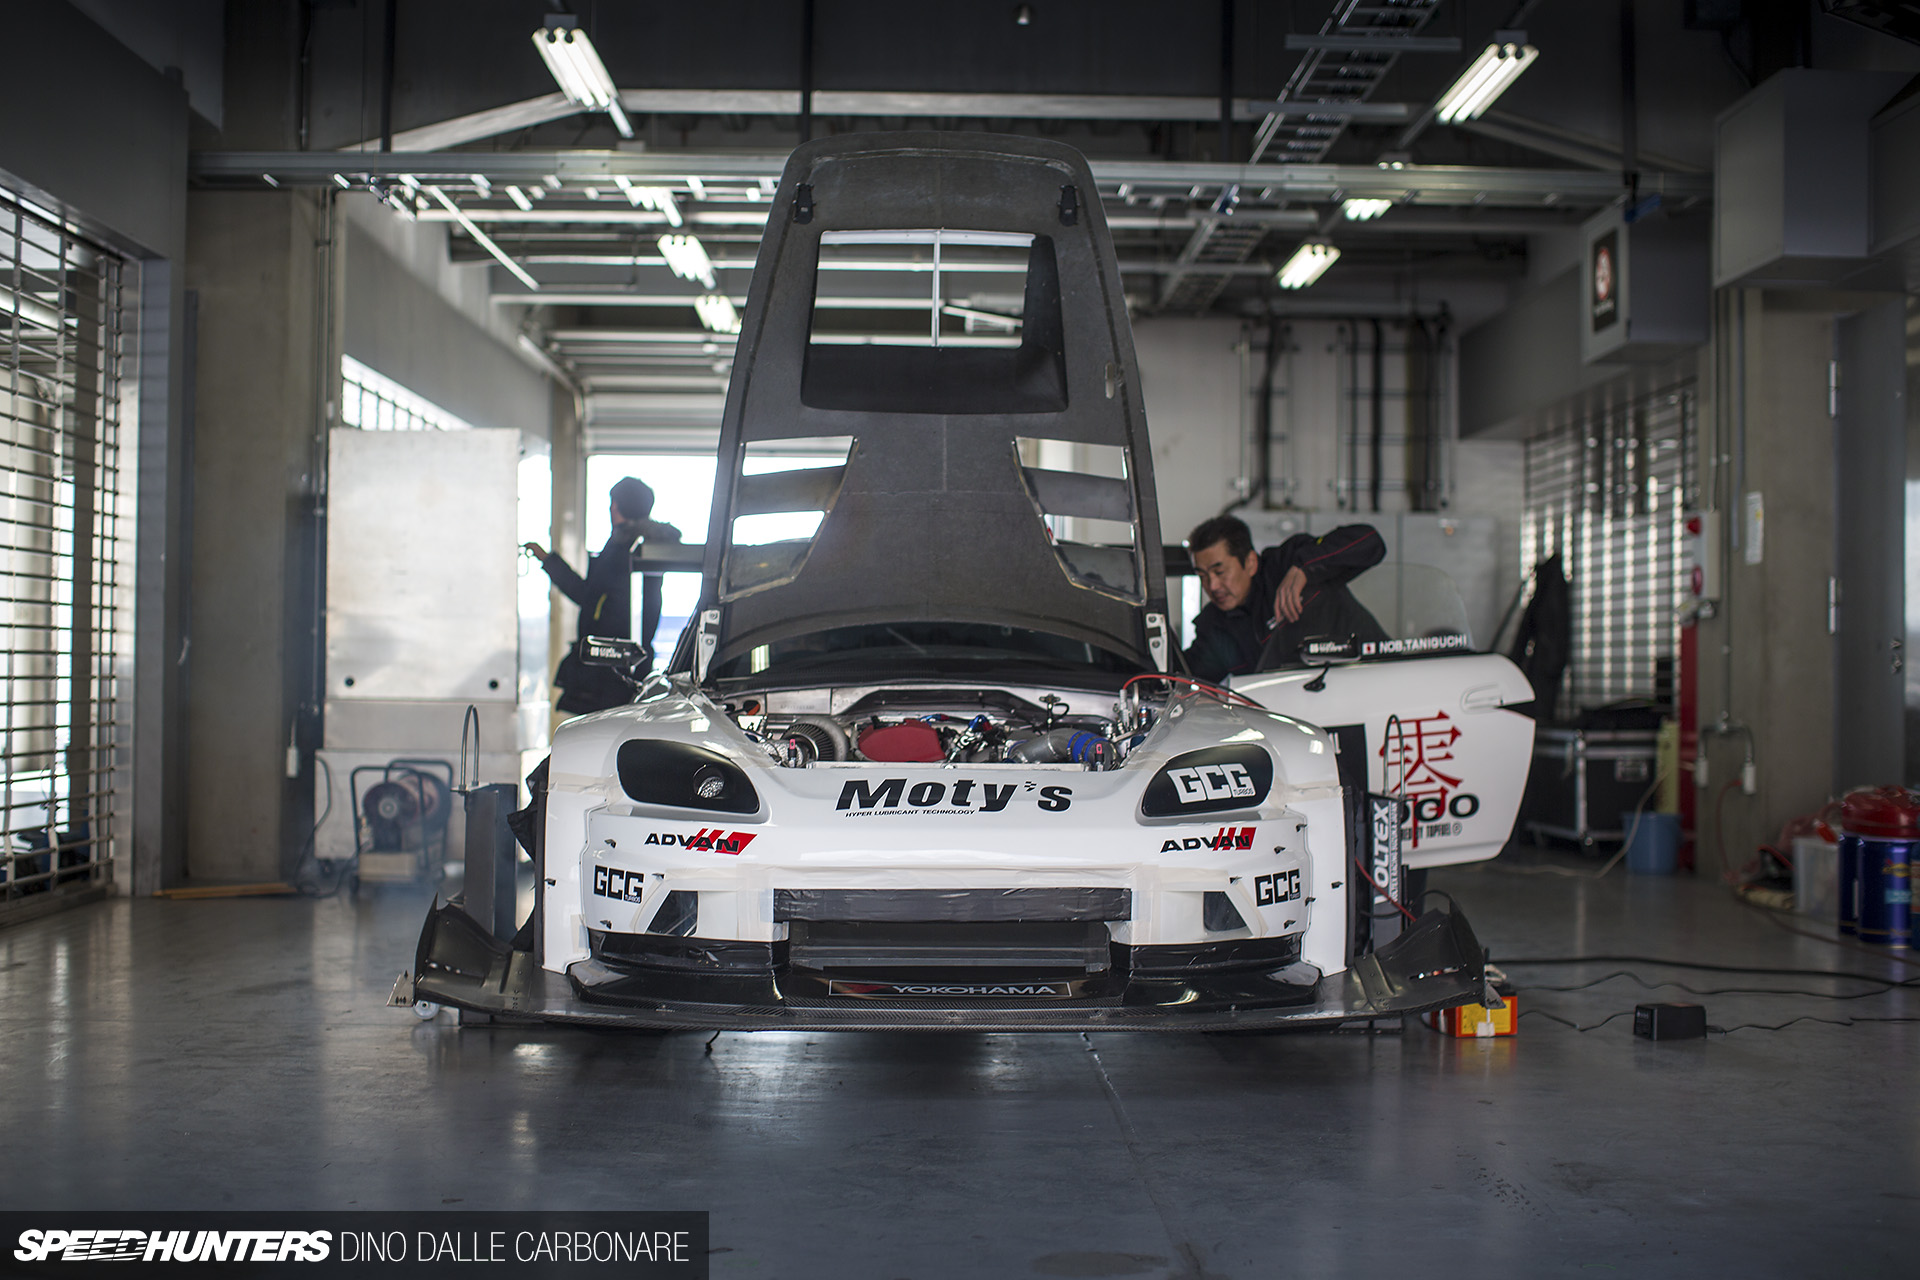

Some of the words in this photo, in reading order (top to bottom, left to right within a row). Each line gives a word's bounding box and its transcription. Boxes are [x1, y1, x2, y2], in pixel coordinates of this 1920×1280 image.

[1379, 635, 1467, 654] NOB.TANIGUCHI
[836, 778, 1073, 813] Moty's
[1167, 763, 1256, 804] GCG
[644, 833, 740, 853] ADVAN
[1160, 835, 1250, 853] ADVAN
[593, 865, 644, 904] GCG
[1254, 869, 1301, 907] GCG
[892, 985, 1057, 995] YOKOHAMA
